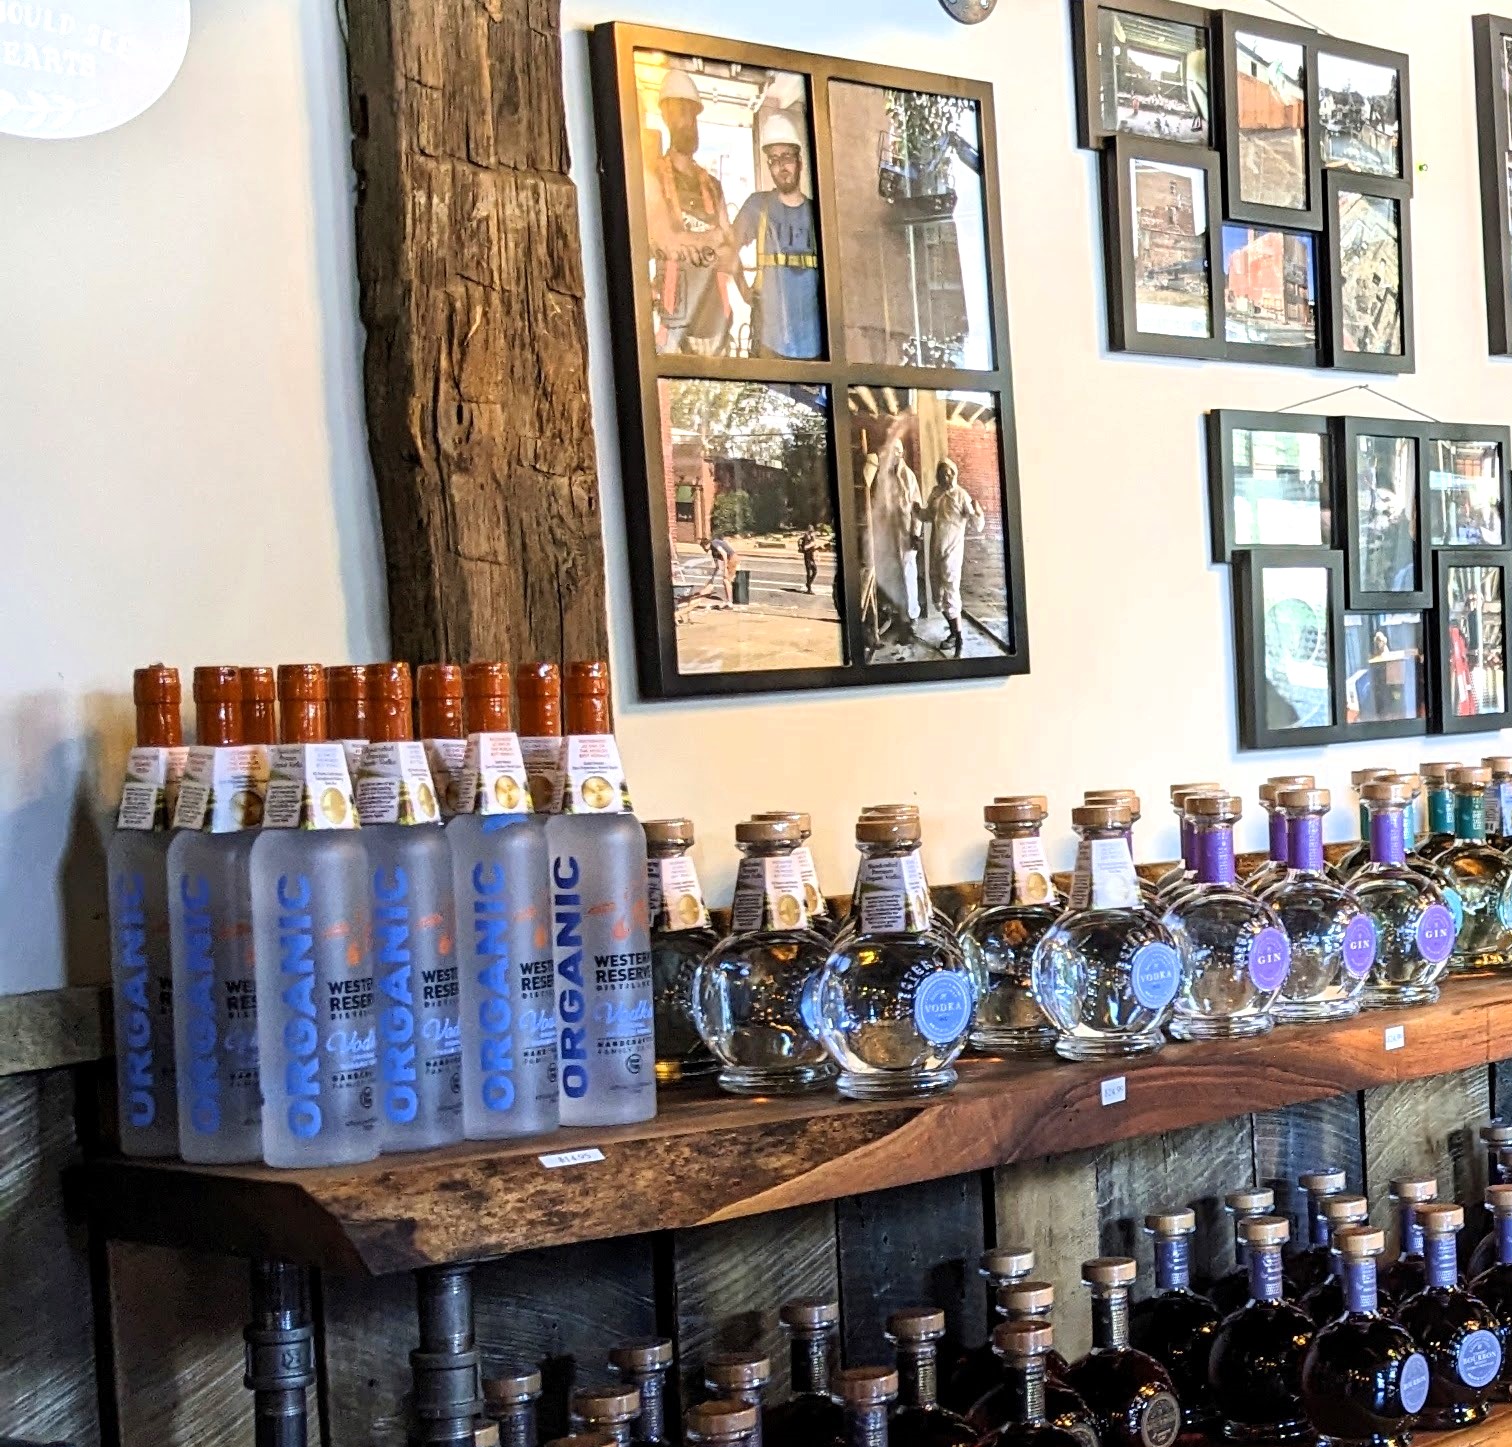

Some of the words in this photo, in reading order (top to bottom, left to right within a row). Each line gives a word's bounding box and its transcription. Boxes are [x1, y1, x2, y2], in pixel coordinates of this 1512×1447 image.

[0, 1, 76, 34] OULD
[1349, 940, 1370, 950] GIN
[1425, 928, 1447, 939] GIN
[1257, 952, 1281, 965] GIN
[472, 861, 515, 1111] ORGANIC
[554, 856, 588, 1098] ORGANIC
[1140, 970, 1172, 983] VODKA
[117, 873, 156, 1128] ORGANIC
[181, 873, 221, 1137] ORGANIC
[277, 874, 322, 1139] ORGANIC
[374, 865, 419, 1123] ORGANIC
[924, 1002, 963, 1013] VODKA
[1463, 1351, 1497, 1365] BOURBON
